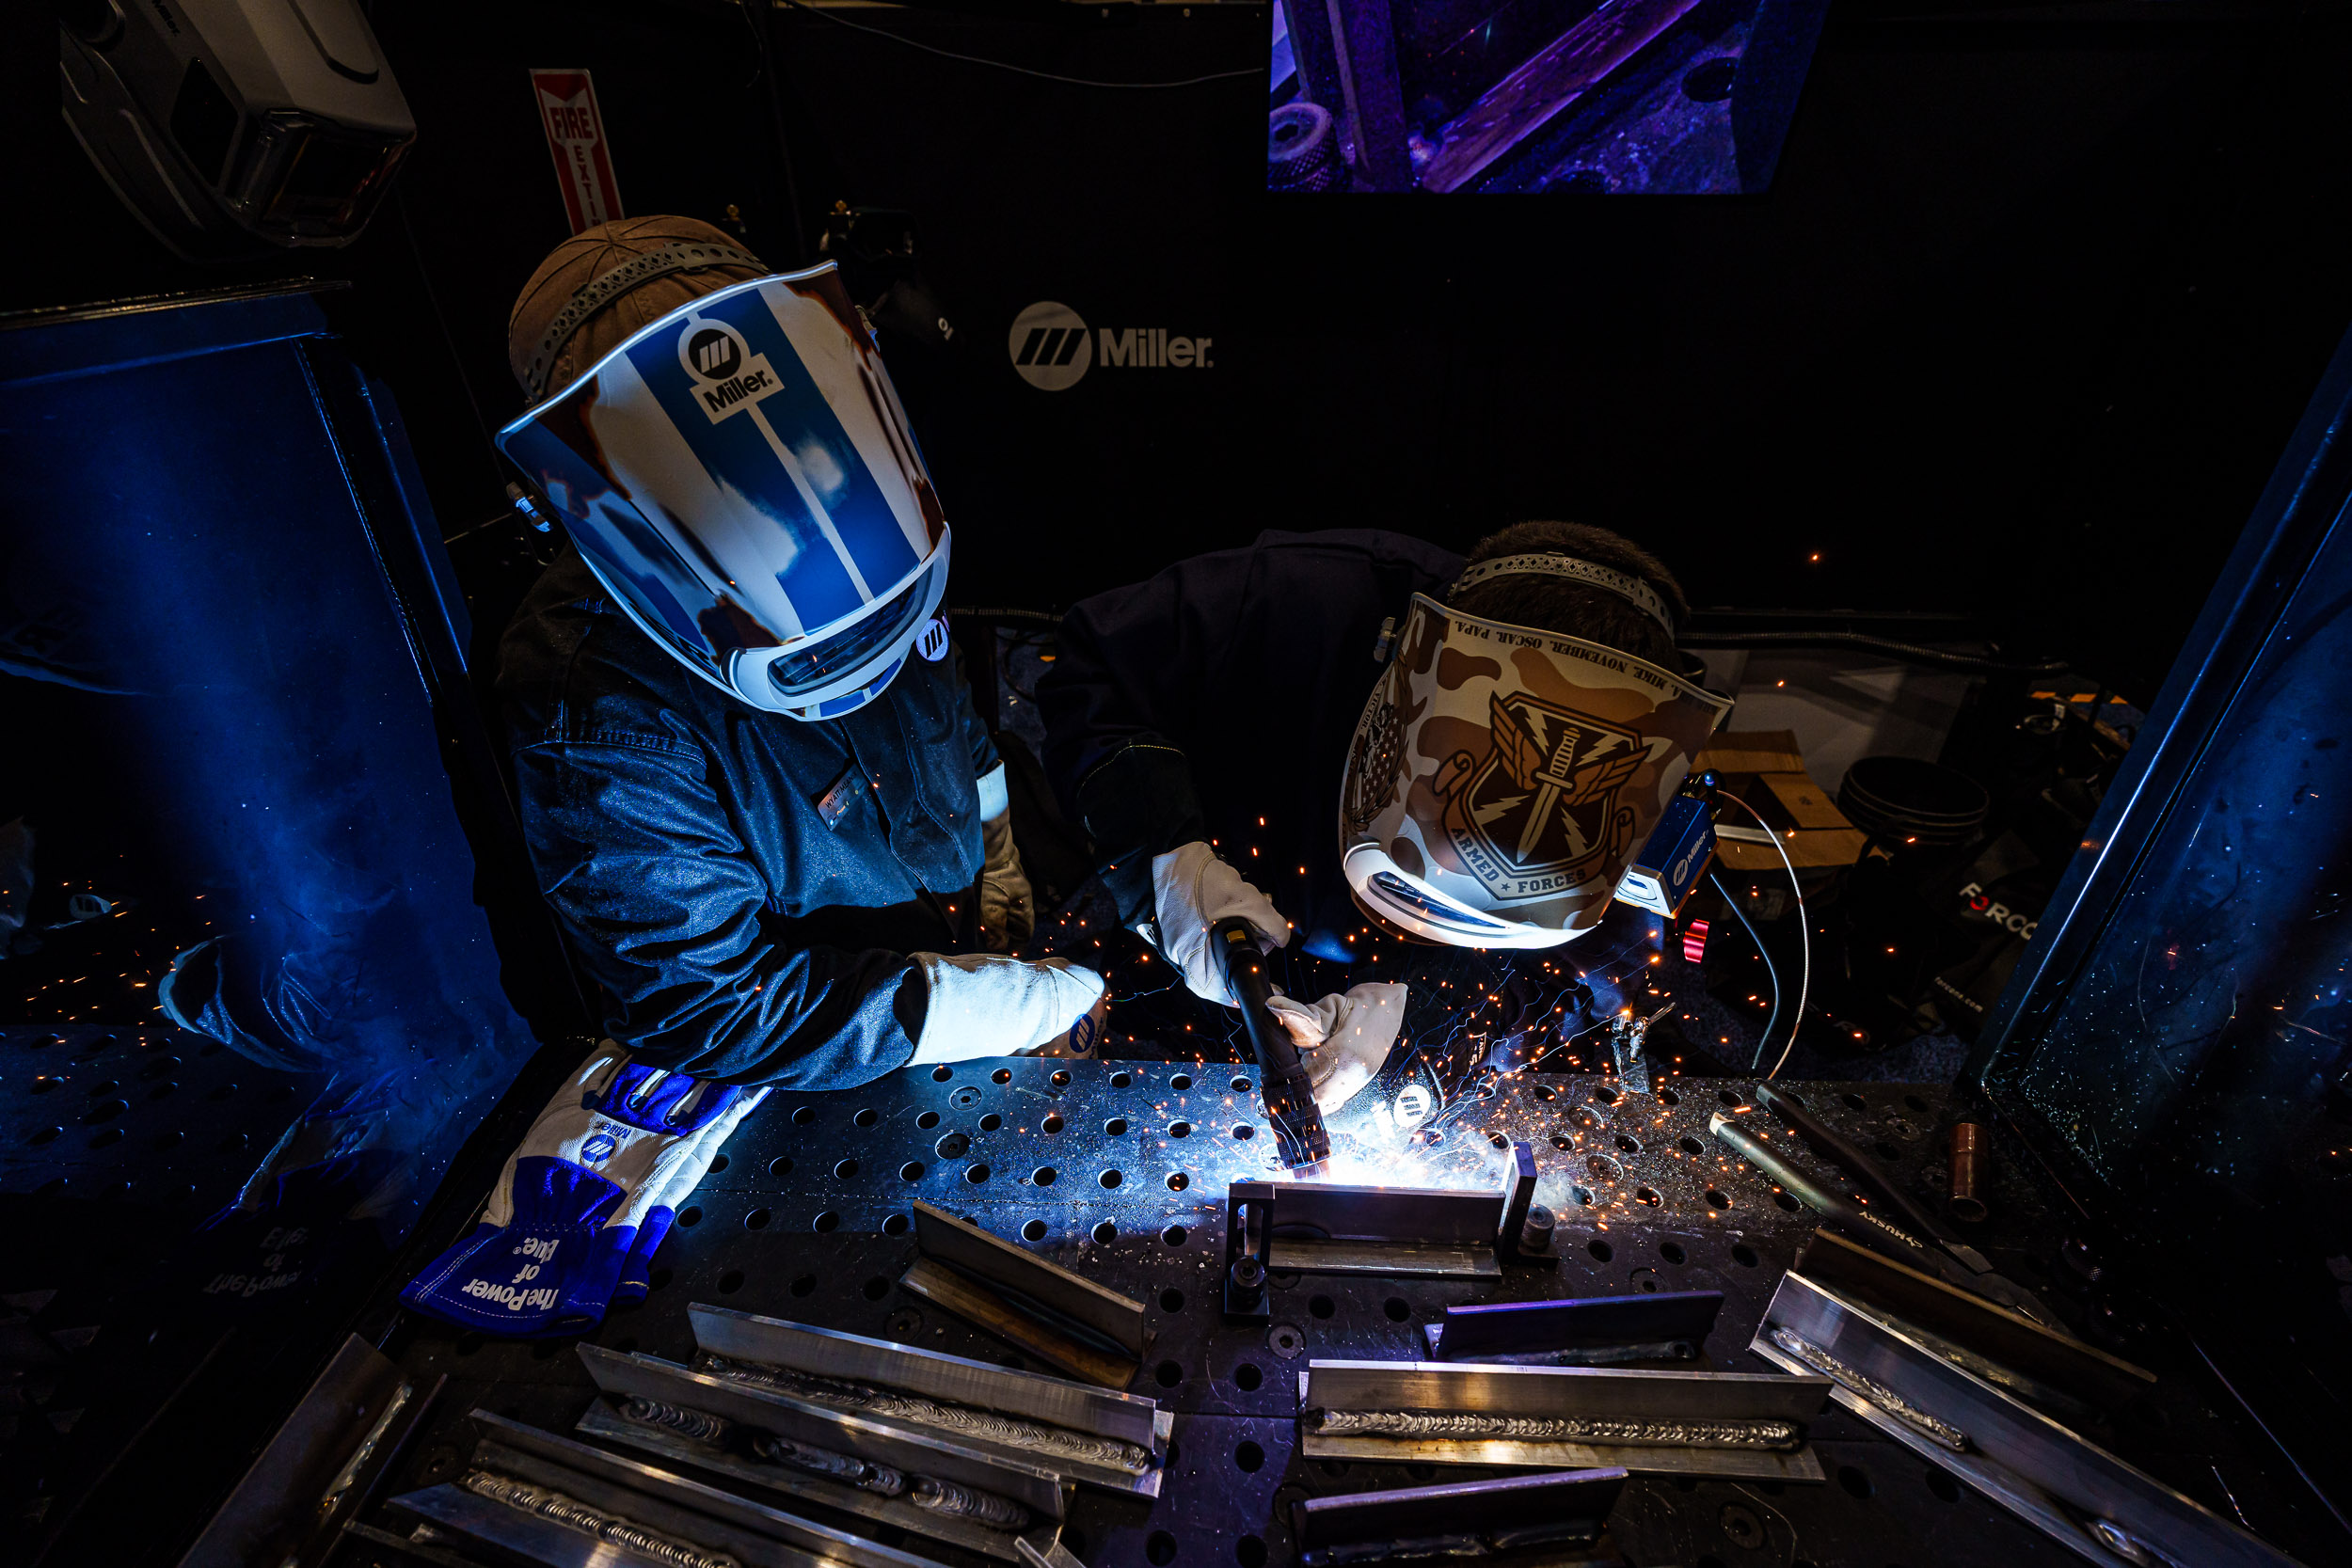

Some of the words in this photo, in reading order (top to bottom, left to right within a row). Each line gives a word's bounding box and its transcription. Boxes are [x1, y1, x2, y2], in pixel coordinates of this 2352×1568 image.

[549, 107, 594, 139] FIRE
[1450, 828, 1500, 881] ARMED
[1518, 868, 1586, 894] FORCES
[1858, 1211, 1906, 1242] HUSKY
[511, 1263, 541, 1284] of
